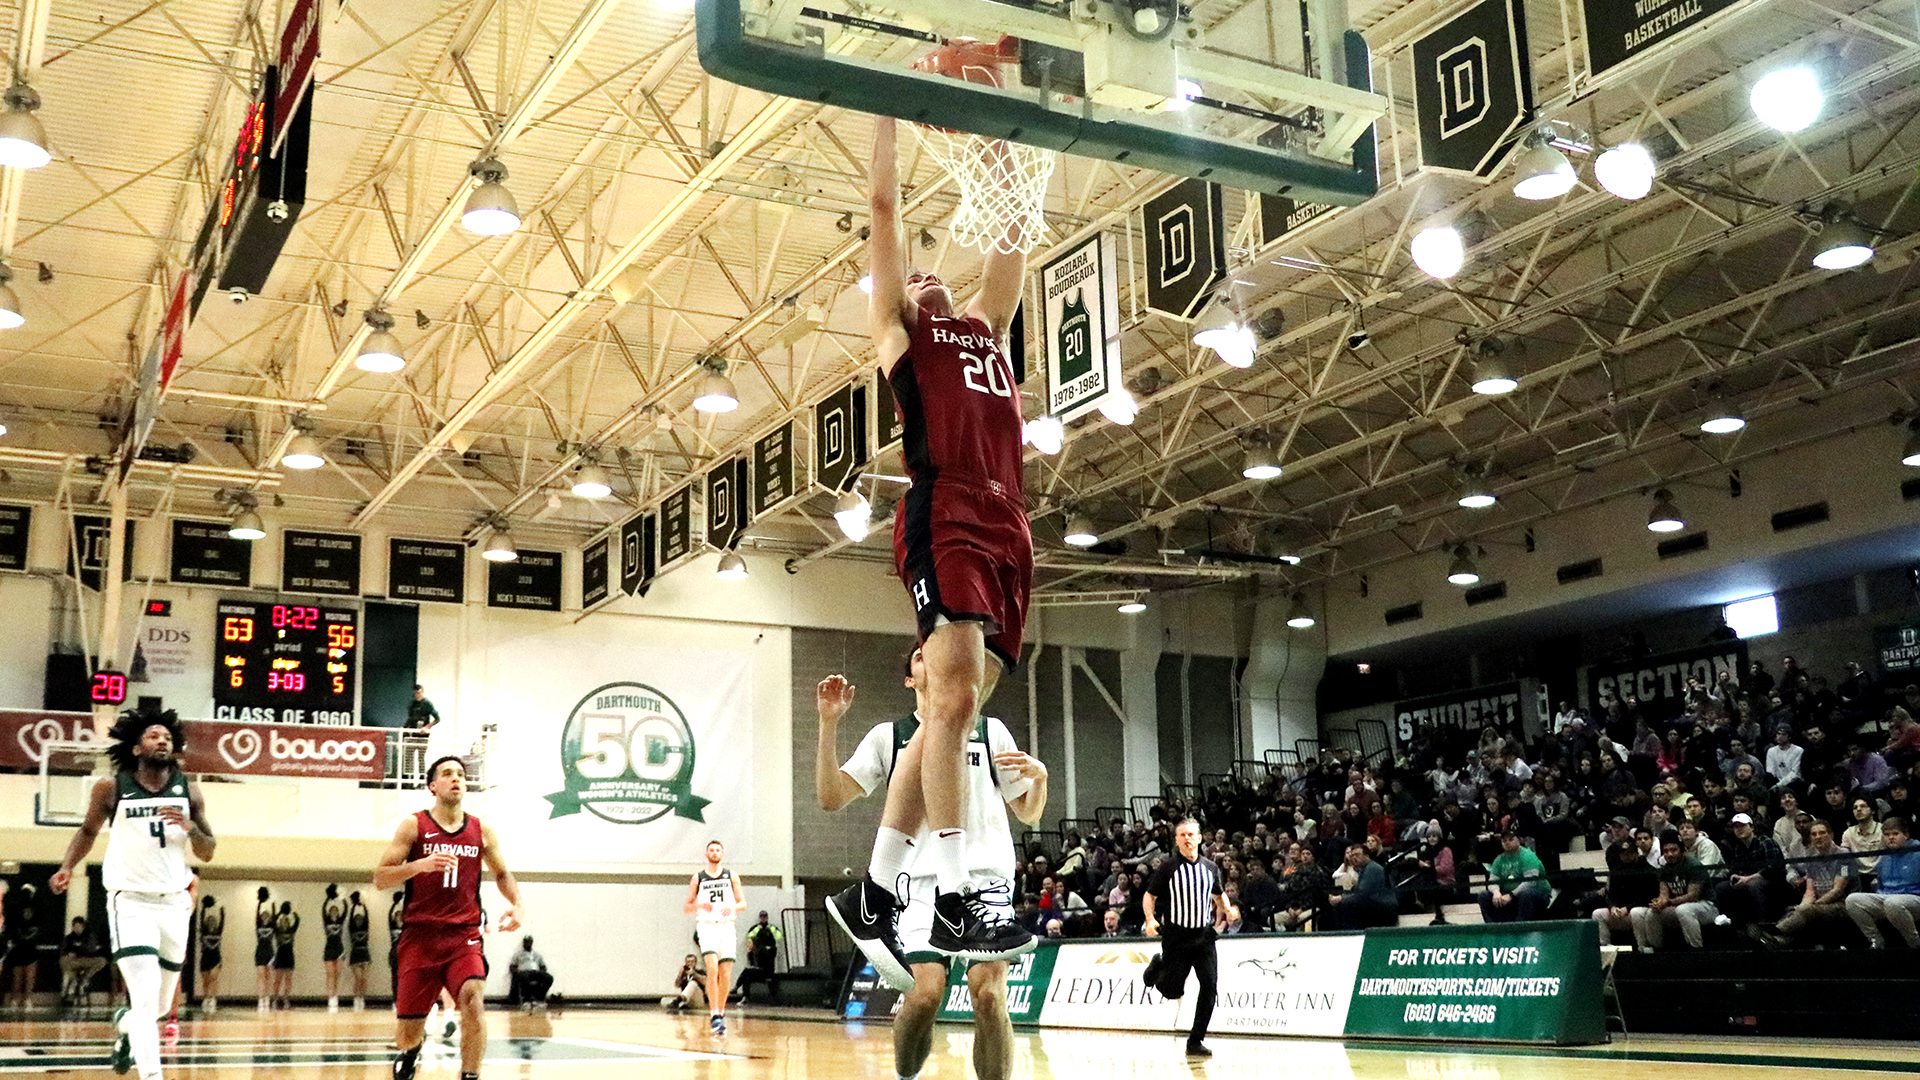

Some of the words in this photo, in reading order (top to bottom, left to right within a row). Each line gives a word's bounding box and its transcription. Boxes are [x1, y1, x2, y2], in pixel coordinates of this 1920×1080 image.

[1624, 0, 1702, 50] BASKETBALL
[1436, 36, 1491, 140] D
[1158, 203, 1196, 289] D
[1054, 251, 1088, 281] KOZIARA
[1049, 262, 1096, 300] BOUDREAUX
[932, 328, 1000, 353] HARV
[1066, 327, 1083, 362] 20
[958, 352, 1012, 398] 20
[1054, 372, 1100, 407] 1978-1982
[913, 578, 930, 612] H
[224, 617, 254, 642] 63
[272, 605, 319, 630] 8:22
[148, 628, 190, 644] DDS
[327, 624, 355, 648] 56
[1883, 645, 1920, 662] DARTMO
[92, 674, 126, 702] 28
[230, 670, 244, 688] 6
[268, 672, 305, 690] 3-03
[333, 676, 344, 693] 5
[1598, 653, 1740, 709] SECTION
[217, 705, 275, 722] CLASS
[282, 710, 305, 724] OF
[312, 710, 350, 726] 1960
[596, 695, 661, 713] DARTMOUTH
[1398, 692, 1518, 741] STUDENT
[270, 730, 376, 762] boloco
[578, 790, 624, 800] WOMEN'S
[625, 790, 678, 802] ATHLETICS
[590, 782, 660, 793] ANNIVERSARY
[606, 805, 625, 814] 1972
[631, 806, 652, 814] 2022
[150, 820, 166, 848] 4
[422, 843, 479, 858] HARVARD
[443, 859, 458, 888] 11
[710, 890, 724, 902] 24
[1388, 950, 1418, 966] FOR
[1423, 948, 1488, 965] TICKETS
[1492, 947, 1540, 964] VISIT:
[1358, 977, 1560, 997] DARTMOUTHSPORTS.COM/TICKETS
[1214, 992, 1286, 1010] ANOVER
[1296, 992, 1335, 1010] INN
[1404, 1002, 1436, 1023] (603)
[1437, 1004, 1496, 1024] 646-2466
[1226, 1017, 1288, 1028] DARTMOUTH
